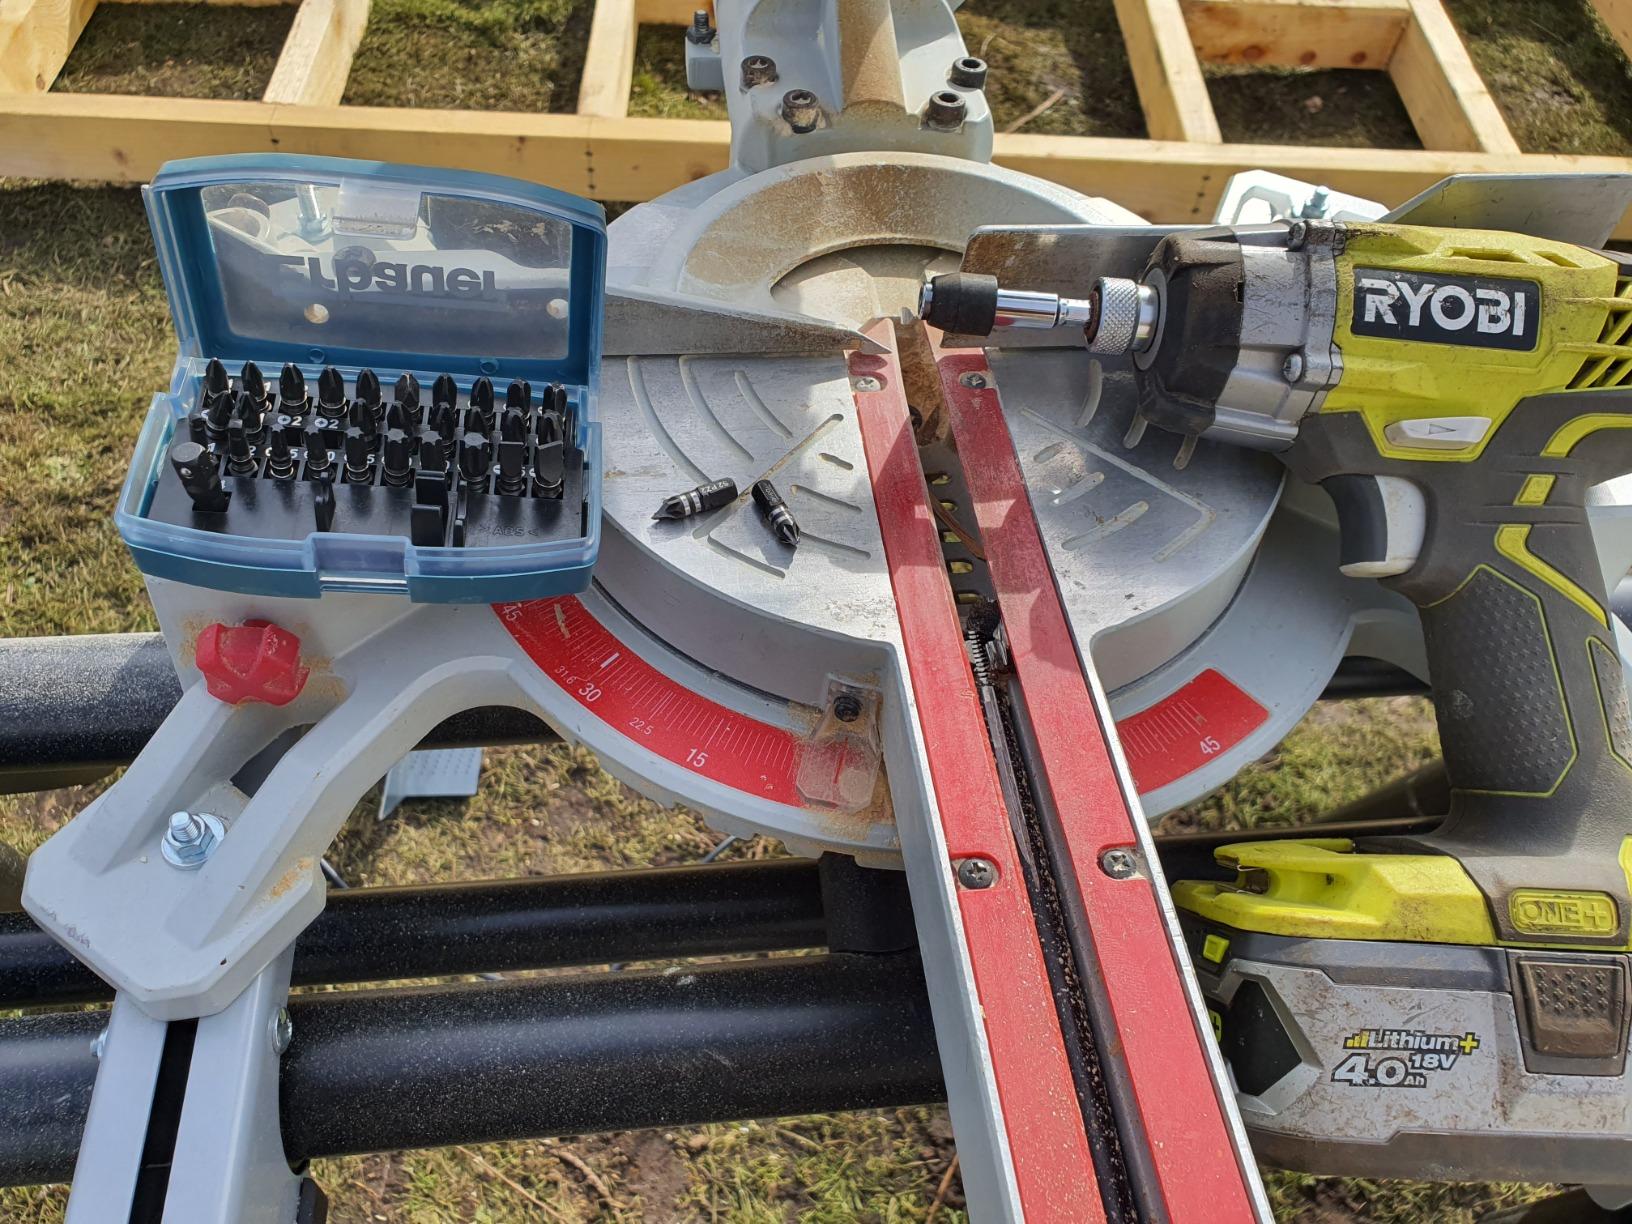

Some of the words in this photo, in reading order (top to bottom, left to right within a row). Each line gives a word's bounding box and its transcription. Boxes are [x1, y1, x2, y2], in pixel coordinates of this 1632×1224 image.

[1358, 278, 1526, 337] RYOBI
[291, 415, 303, 426] 2
[328, 419, 340, 429] 2
[503, 604, 523, 621] 45
[578, 682, 602, 702] 30
[628, 716, 655, 736] 22.5
[1200, 735, 1221, 755] 45
[685, 747, 709, 768] 15
[1411, 1053, 1457, 1069] 18V
